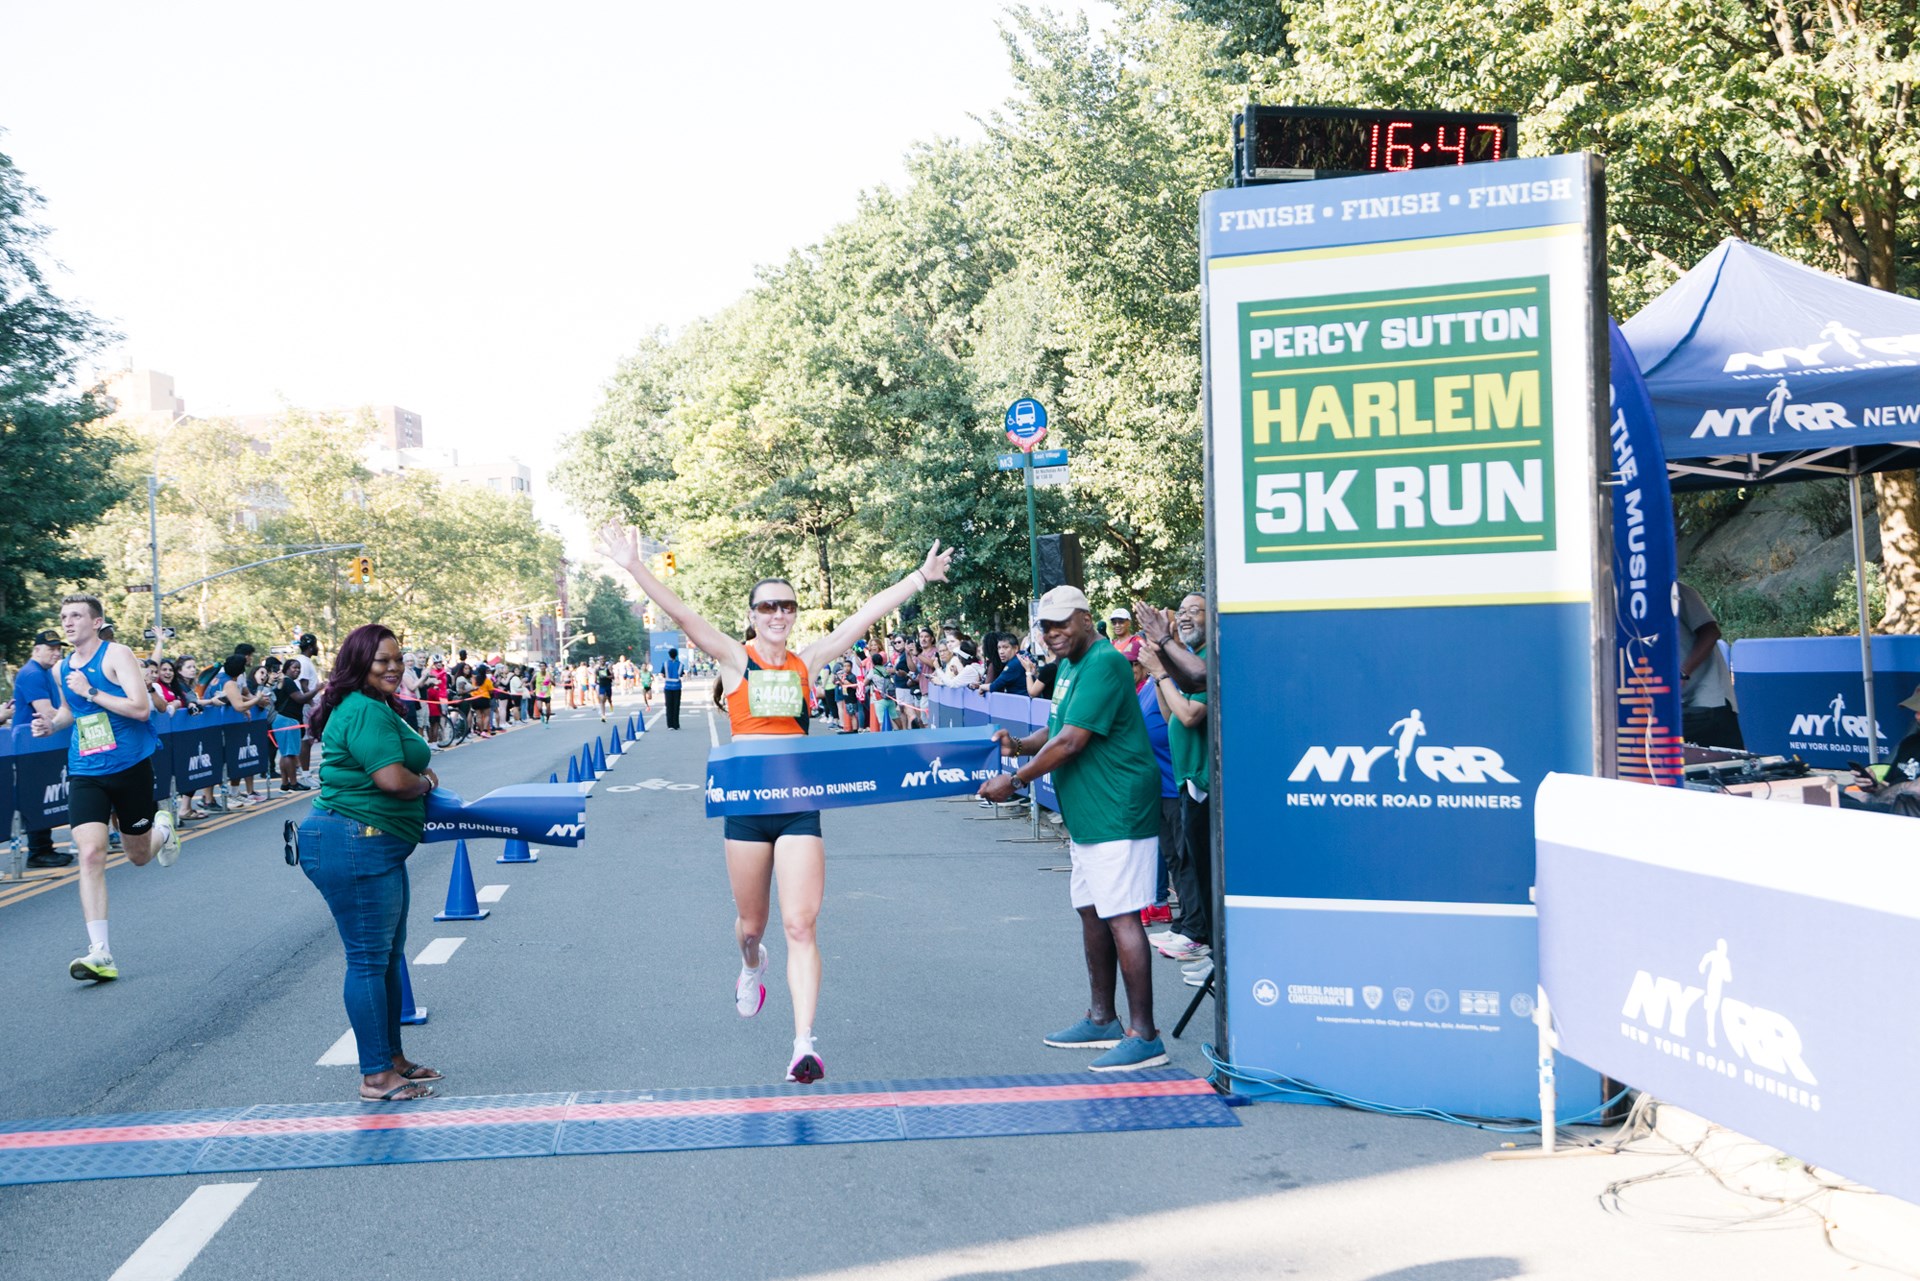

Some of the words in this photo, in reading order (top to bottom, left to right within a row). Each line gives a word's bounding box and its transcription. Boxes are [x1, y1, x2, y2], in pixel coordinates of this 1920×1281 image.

[1219, 204, 1315, 232] FINISH
[1341, 192, 1441, 222] FINISH
[1468, 178, 1572, 209] FINISH
[1250, 320, 1370, 360] PERCY
[1380, 305, 1539, 351] SUTTON
[1252, 369, 1541, 445] HARLEM
[1690, 402, 1857, 438] NYRR
[1863, 404, 1920, 427] NEW
[1000, 457, 1013, 468] M3
[1255, 468, 1359, 536] 5K
[1375, 458, 1543, 530] RUN
[1610, 407, 1638, 487] THE
[1624, 488, 1647, 620] MUSIC
[763, 685, 801, 704] 4402
[1287, 745, 1521, 783] NYRR
[1789, 741, 1807, 750] NEW
[1808, 742, 1829, 751] YORK
[1830, 743, 1852, 752] ROAD
[726, 789, 750, 802] NEW
[753, 787, 790, 800] YORK
[792, 784, 824, 798] ROAD
[826, 780, 877, 795] RUNNERS
[901, 768, 970, 788] NYRR
[971, 769, 999, 780] NEW
[1286, 793, 1326, 807] NEW
[1330, 793, 1377, 807] YORK
[1382, 794, 1432, 808] ROAD
[1437, 795, 1523, 809] RUNNERS
[458, 822, 519, 835] RUNNERS
[1288, 984, 1323, 996] CENTRAL
[1323, 986, 1345, 997] PARK
[1288, 993, 1345, 1006] CONSERVANCY
[1621, 969, 1819, 1087] NYRR
[1620, 1022, 1649, 1044] NEW
[1654, 1035, 1690, 1061] YORK
[1696, 1051, 1737, 1078] ROAD
[1744, 1068, 1821, 1112] RUNNERS
